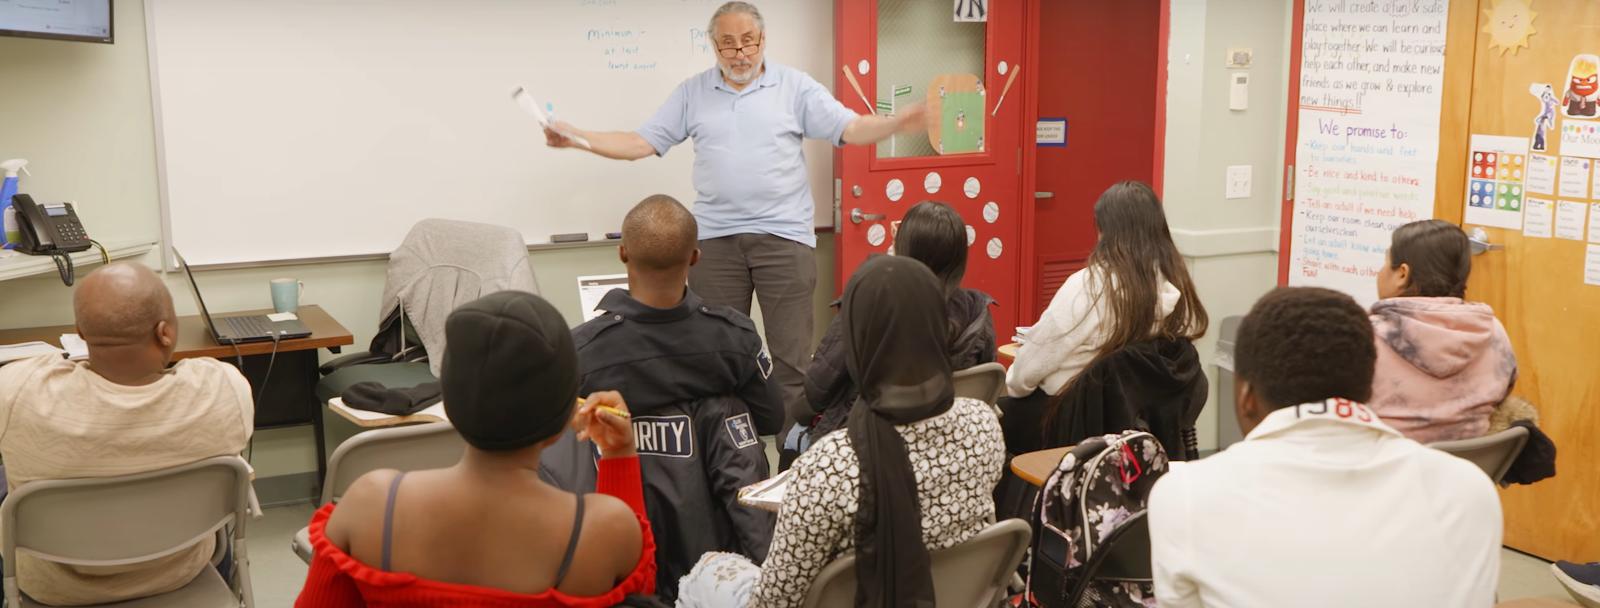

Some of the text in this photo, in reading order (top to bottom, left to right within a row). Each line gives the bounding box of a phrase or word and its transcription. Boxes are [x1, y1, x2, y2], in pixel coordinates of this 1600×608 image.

[1308, 0, 1444, 13] We will create a fun & safe
[1305, 19, 1441, 38] place where we can learn and
[1304, 38, 1322, 58] play
[1365, 38, 1379, 53] We
[1382, 40, 1397, 53] will
[1400, 41, 1412, 54] be
[1304, 55, 1441, 75] help each other, and make new
[1302, 75, 1433, 98] friends as we grow & explore
[1300, 95, 1319, 106] new
[1318, 118, 1408, 145] We promise to:
[1562, 133, 1579, 143] Our
[1350, 142, 1374, 154] hands
[1377, 146, 1394, 155] and
[1399, 147, 1417, 156] feet
[1311, 153, 1320, 162] to
[1323, 170, 1340, 179] nice
[1343, 170, 1358, 181] and
[1360, 170, 1377, 182] kind
[1380, 173, 1389, 182] to
[1341, 187, 1357, 196] and
[1307, 198, 1321, 208] Tell
[1323, 202, 1332, 210] an
[1335, 201, 1354, 212] adult
[1357, 203, 1363, 213] if
[1364, 207, 1375, 215] we
[1377, 206, 1396, 217] need
[1327, 214, 1339, 222] our
[1342, 217, 1362, 226] room
[1351, 241, 1370, 252] know
[1341, 265, 1358, 276] each
